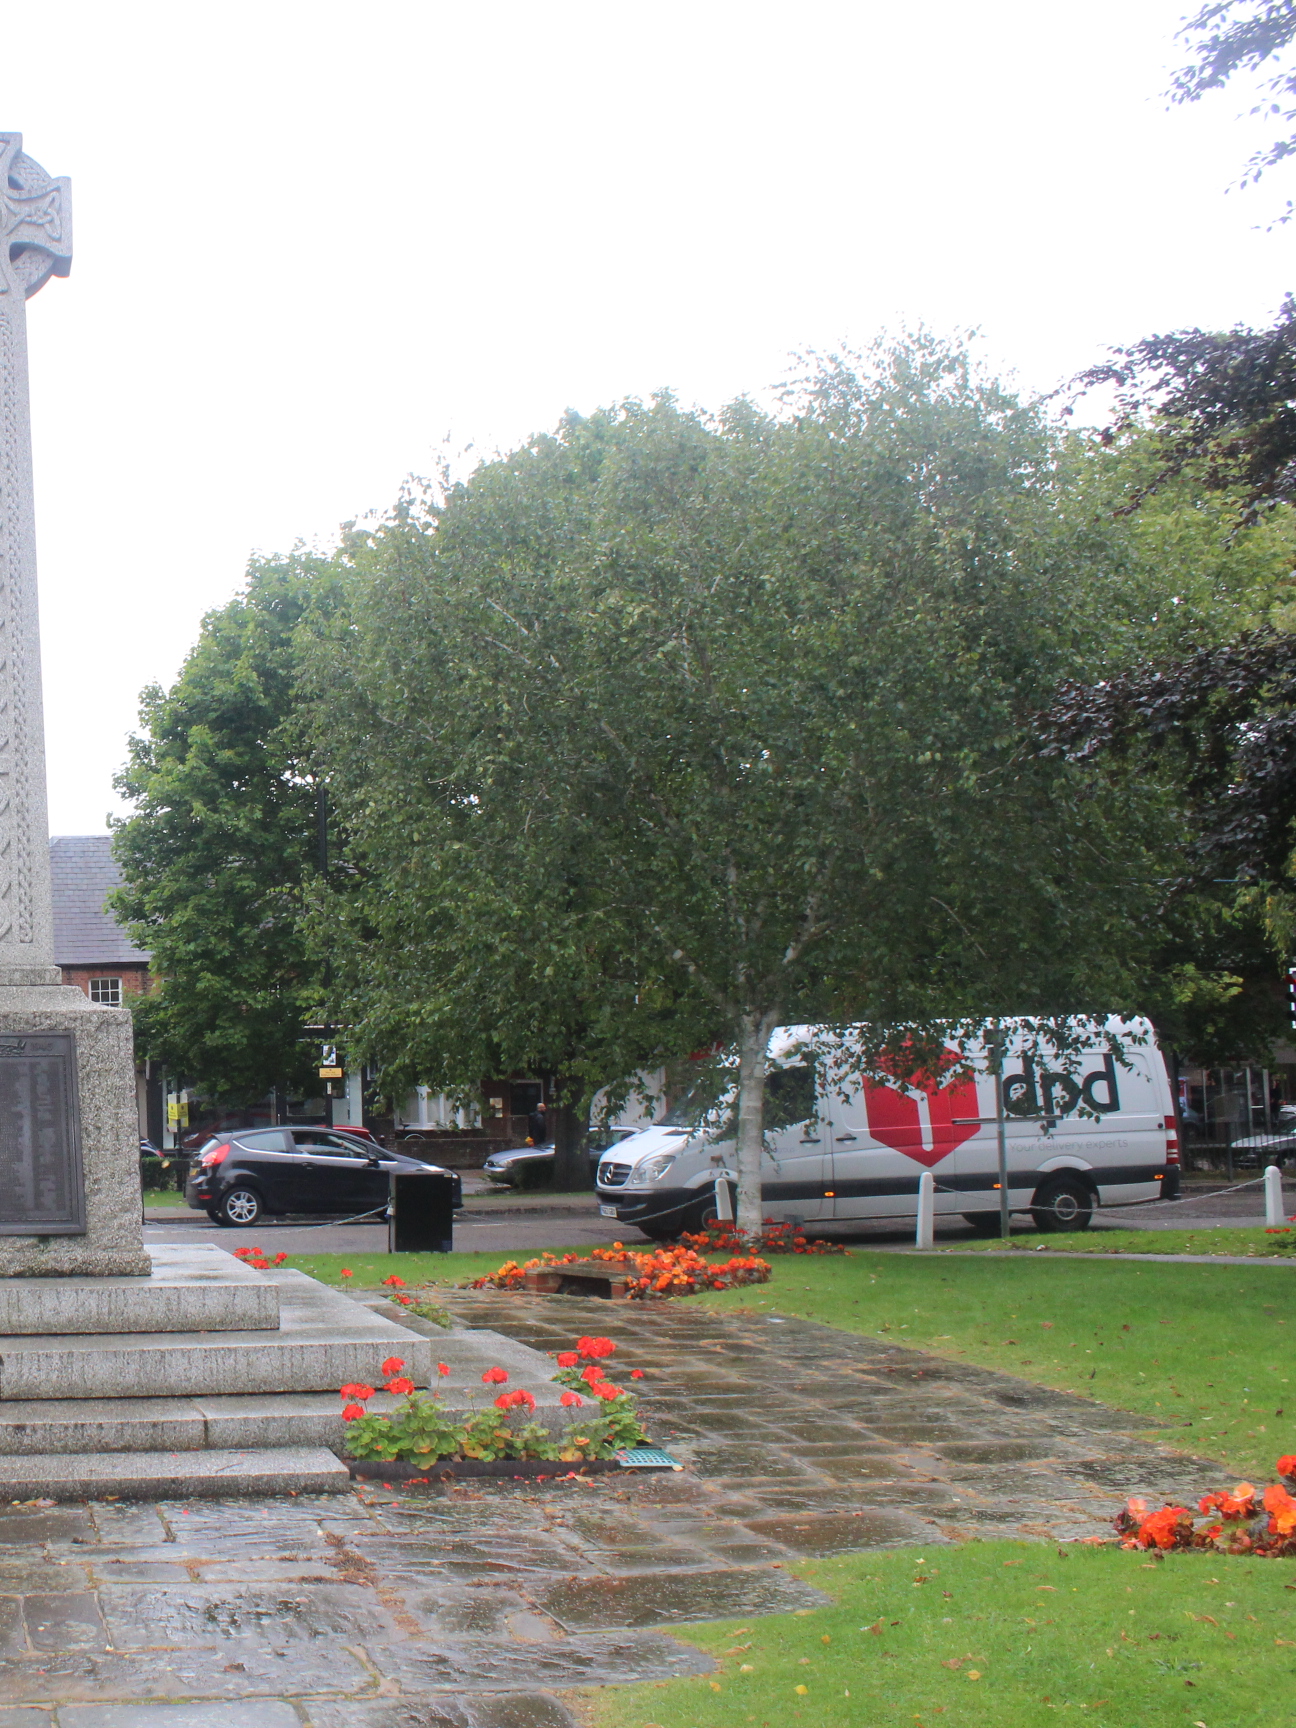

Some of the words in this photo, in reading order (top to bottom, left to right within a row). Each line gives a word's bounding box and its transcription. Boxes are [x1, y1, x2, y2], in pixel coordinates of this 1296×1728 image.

[1003, 1053, 1120, 1128] dpd
[1008, 1142, 1036, 1152] Your
[1038, 1140, 1083, 1153] delivery
[1085, 1139, 1129, 1151] experts
